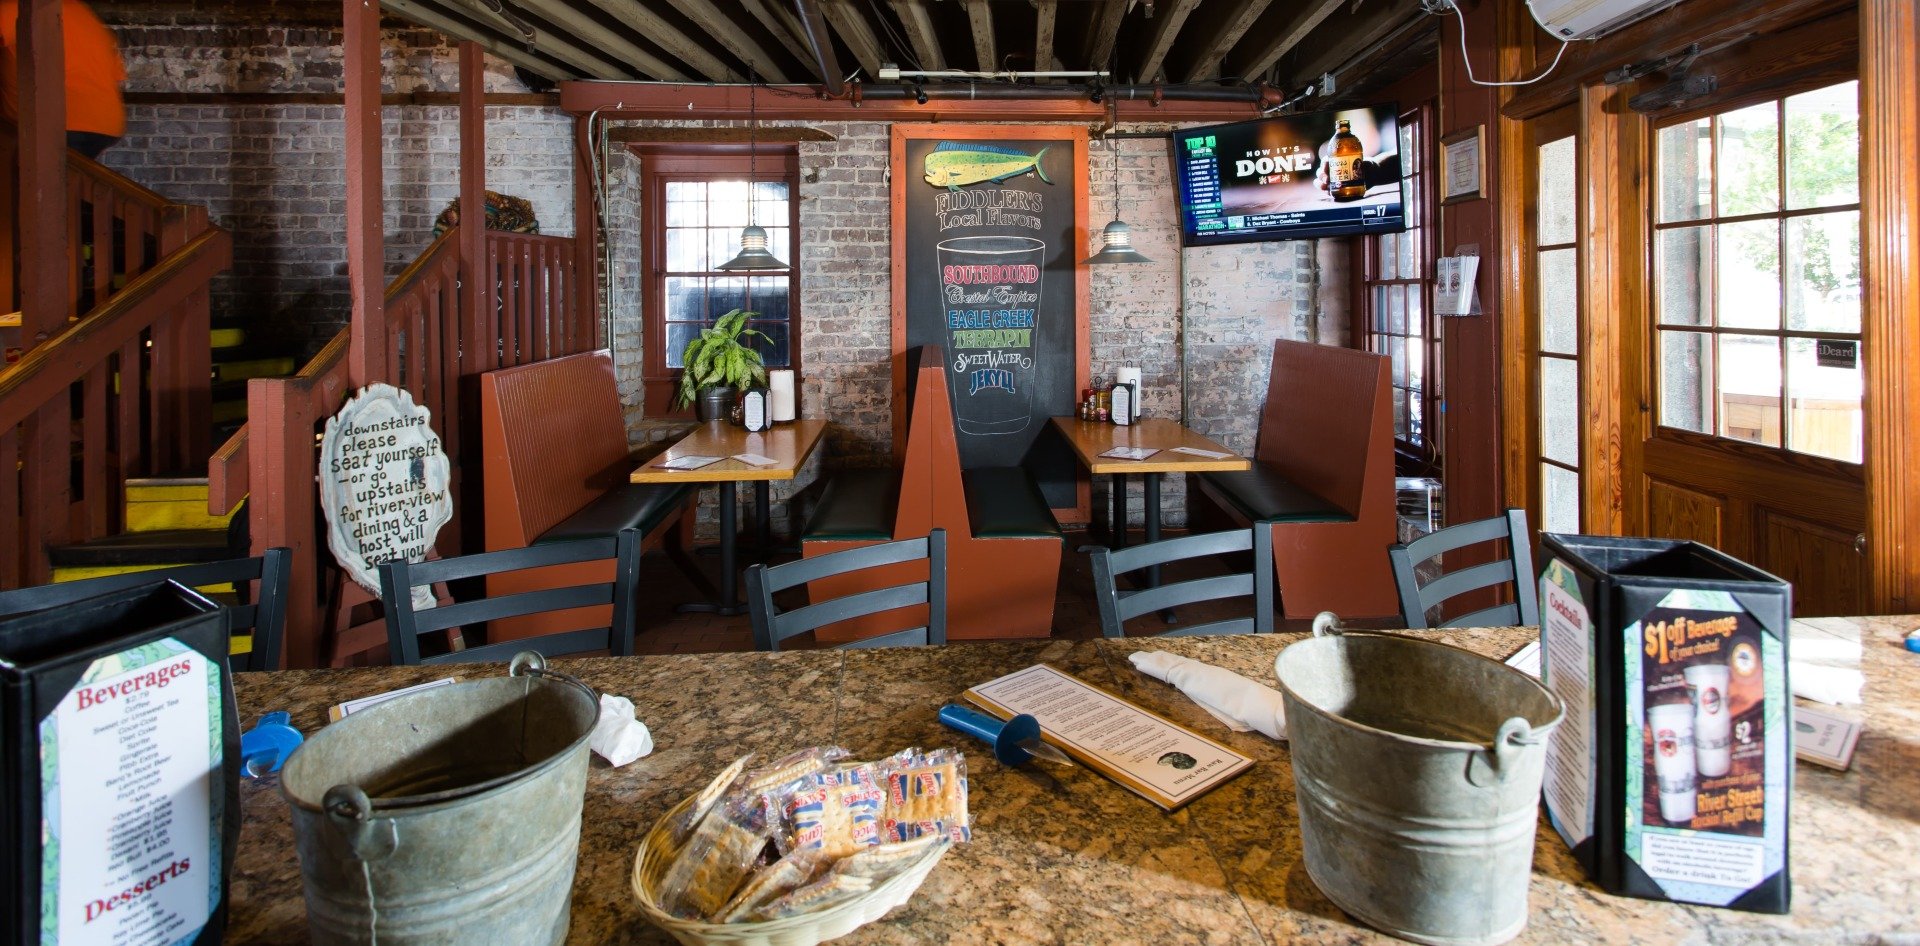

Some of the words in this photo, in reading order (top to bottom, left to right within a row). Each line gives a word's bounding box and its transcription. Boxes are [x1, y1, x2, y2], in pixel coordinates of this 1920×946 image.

[1185, 137, 1204, 150] TOP
[1246, 149, 1270, 157] HOW
[1277, 146, 1299, 154] IT'S
[1236, 153, 1311, 177] DONE
[935, 189, 1043, 216] FIDDLER'S
[1377, 205, 1386, 216] 17
[940, 208, 983, 232] Local
[986, 208, 1041, 230] Flavors
[944, 265, 1039, 284] SOUTHBOUND
[945, 284, 991, 304] Coastal
[992, 285, 1038, 309] Empire
[948, 310, 990, 329] EAGLE
[992, 309, 1035, 328] CREEK
[953, 328, 1032, 349] TERRAPIN
[969, 369, 1015, 396] JEKYLL
[344, 415, 425, 437] downstairs
[331, 450, 371, 473] seat
[376, 438, 439, 471] yourself
[342, 434, 397, 456] please
[356, 477, 426, 505] upstairs
[371, 471, 387, 489] go
[340, 505, 363, 524] for
[367, 490, 445, 518] river-view
[353, 515, 400, 538] dining
[403, 509, 415, 527] &
[418, 508, 429, 523] a
[359, 535, 392, 554] host
[399, 525, 425, 544] will
[365, 547, 398, 570] seat
[402, 544, 425, 563] you
[1645, 621, 1670, 664] $1
[1667, 616, 1686, 646] off
[1687, 616, 1737, 639] Beverage
[77, 659, 191, 711] Beverages
[1735, 721, 1751, 744] $2
[920, 773, 936, 796] Lance
[1697, 792, 1727, 813] River
[1727, 786, 1763, 808] Street
[1745, 806, 1763, 822] Cup
[84, 857, 190, 924] Desserts
